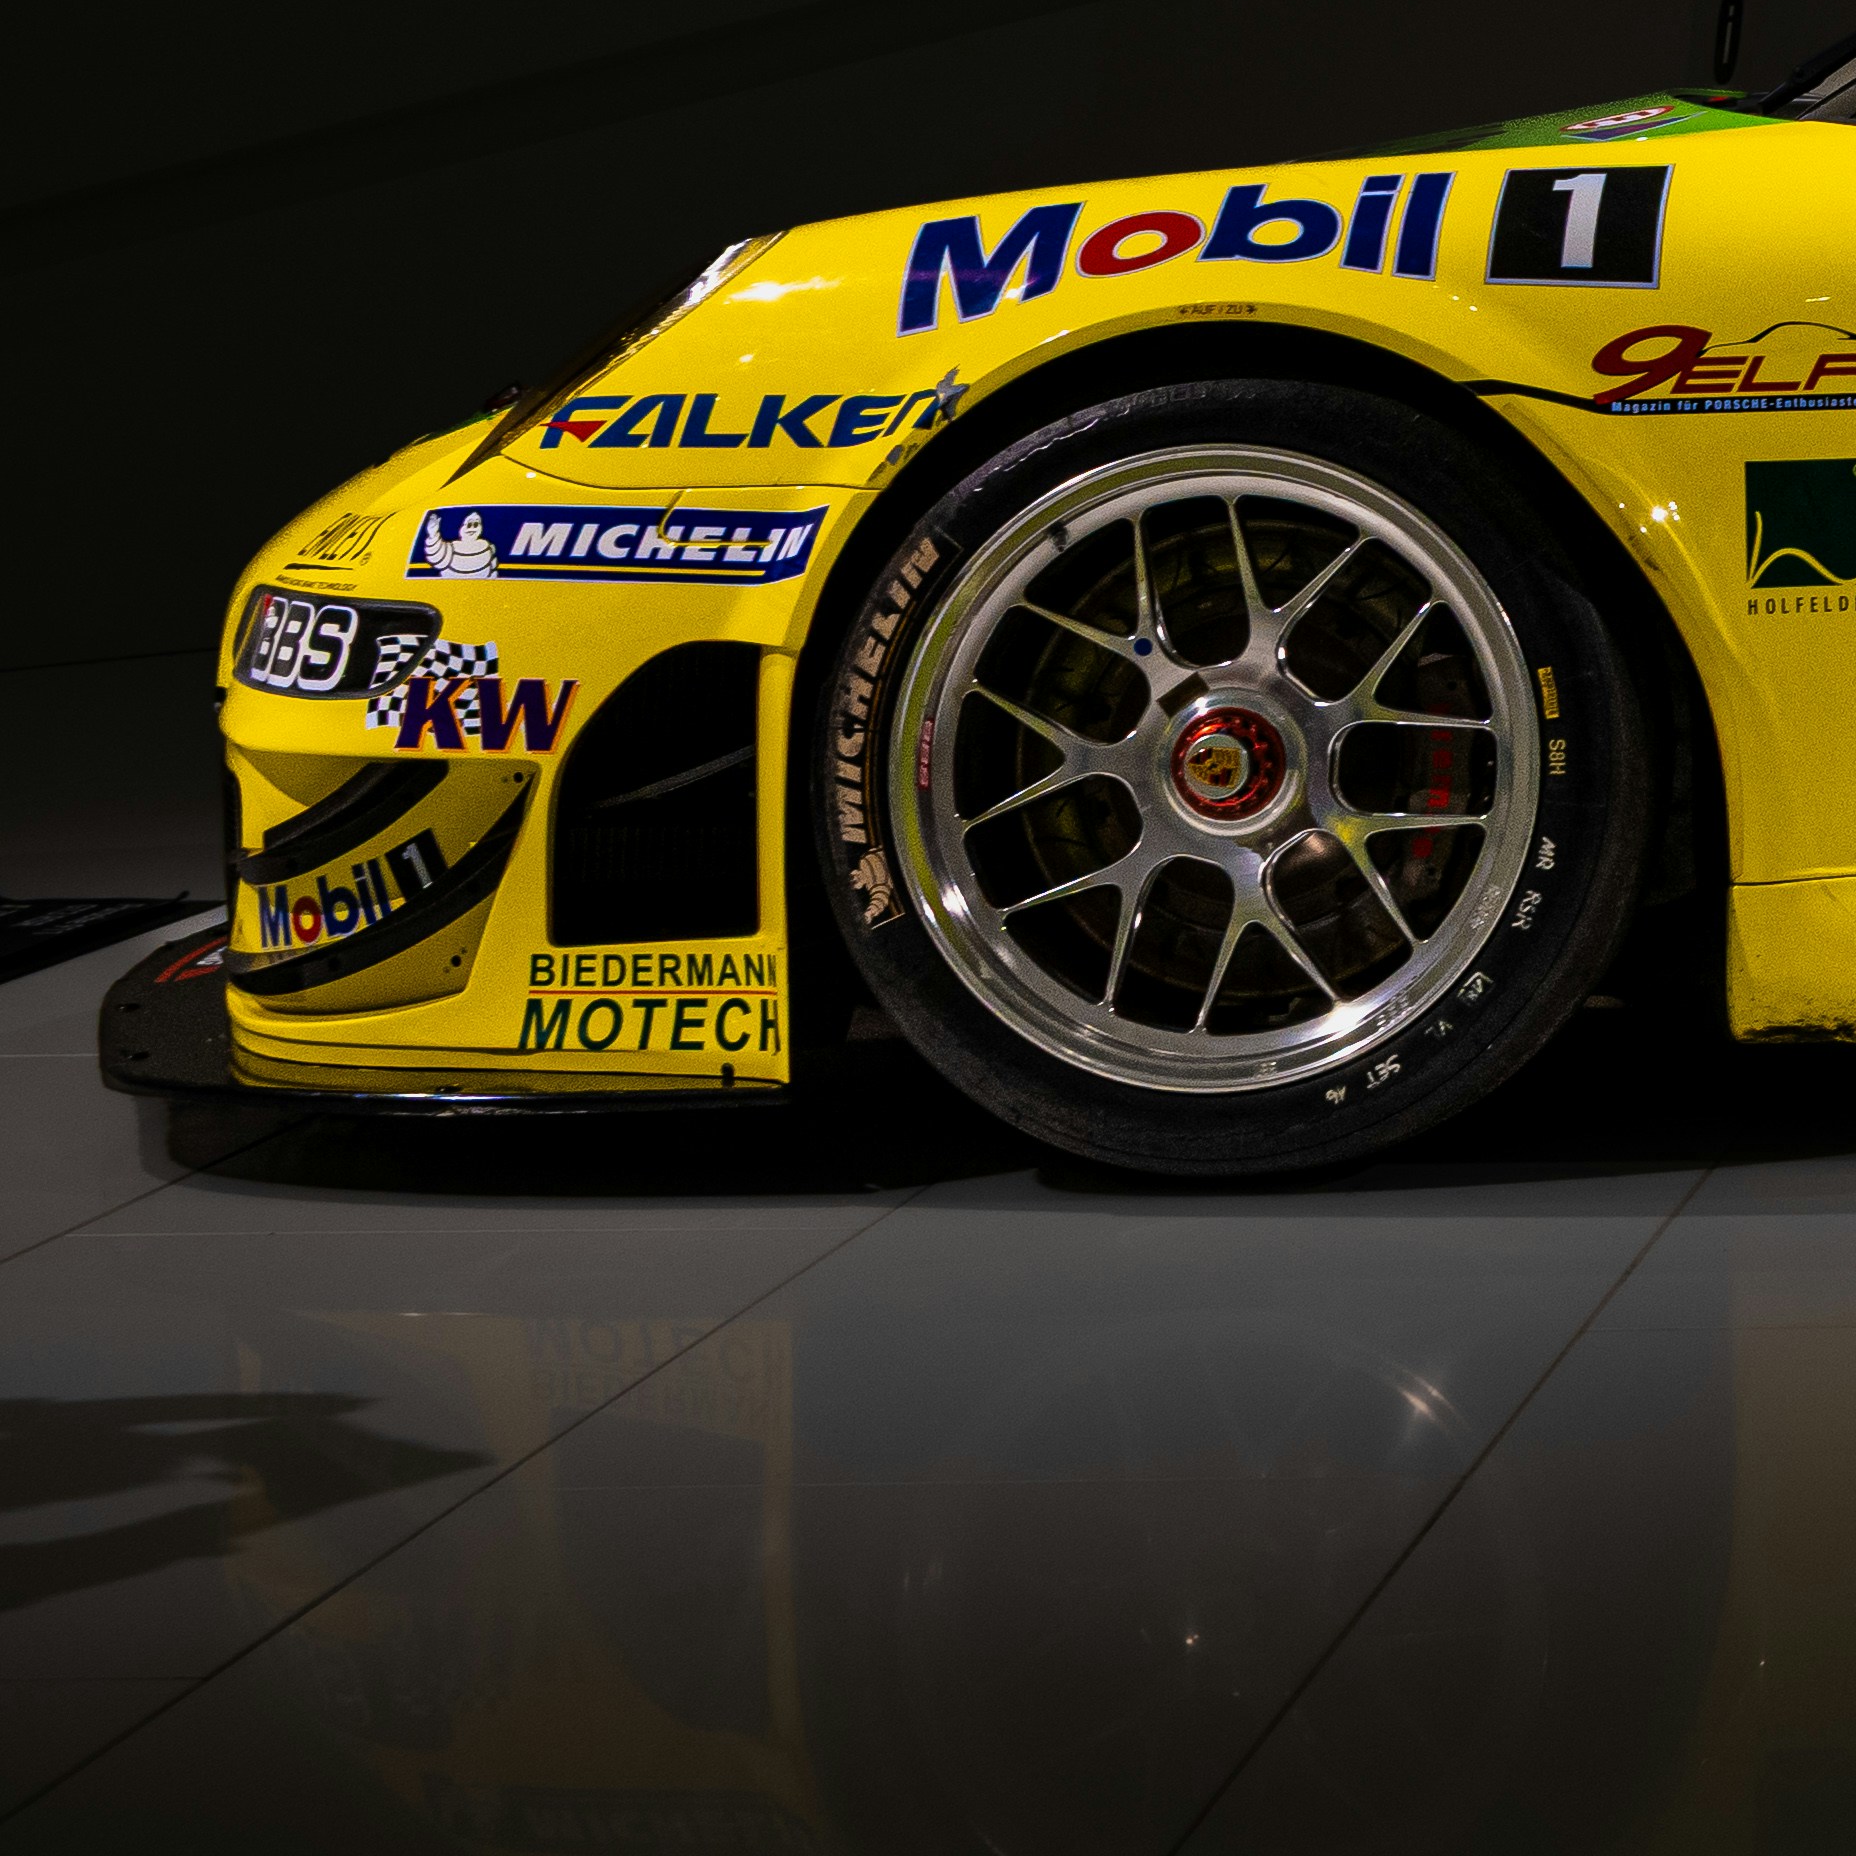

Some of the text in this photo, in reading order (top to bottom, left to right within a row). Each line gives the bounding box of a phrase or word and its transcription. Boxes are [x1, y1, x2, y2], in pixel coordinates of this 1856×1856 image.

[897, 170, 1606, 337] Mobil 1
[1611, 401, 1671, 413] Magazin
[1677, 400, 1698, 411] für
[510, 521, 816, 563] MICHELIN
[250, 594, 359, 692] BBS
[395, 677, 577, 751] KW
[836, 537, 940, 845] MICHELIN
[258, 843, 434, 949] Mobil 1
[519, 999, 778, 1053] MOTECH
